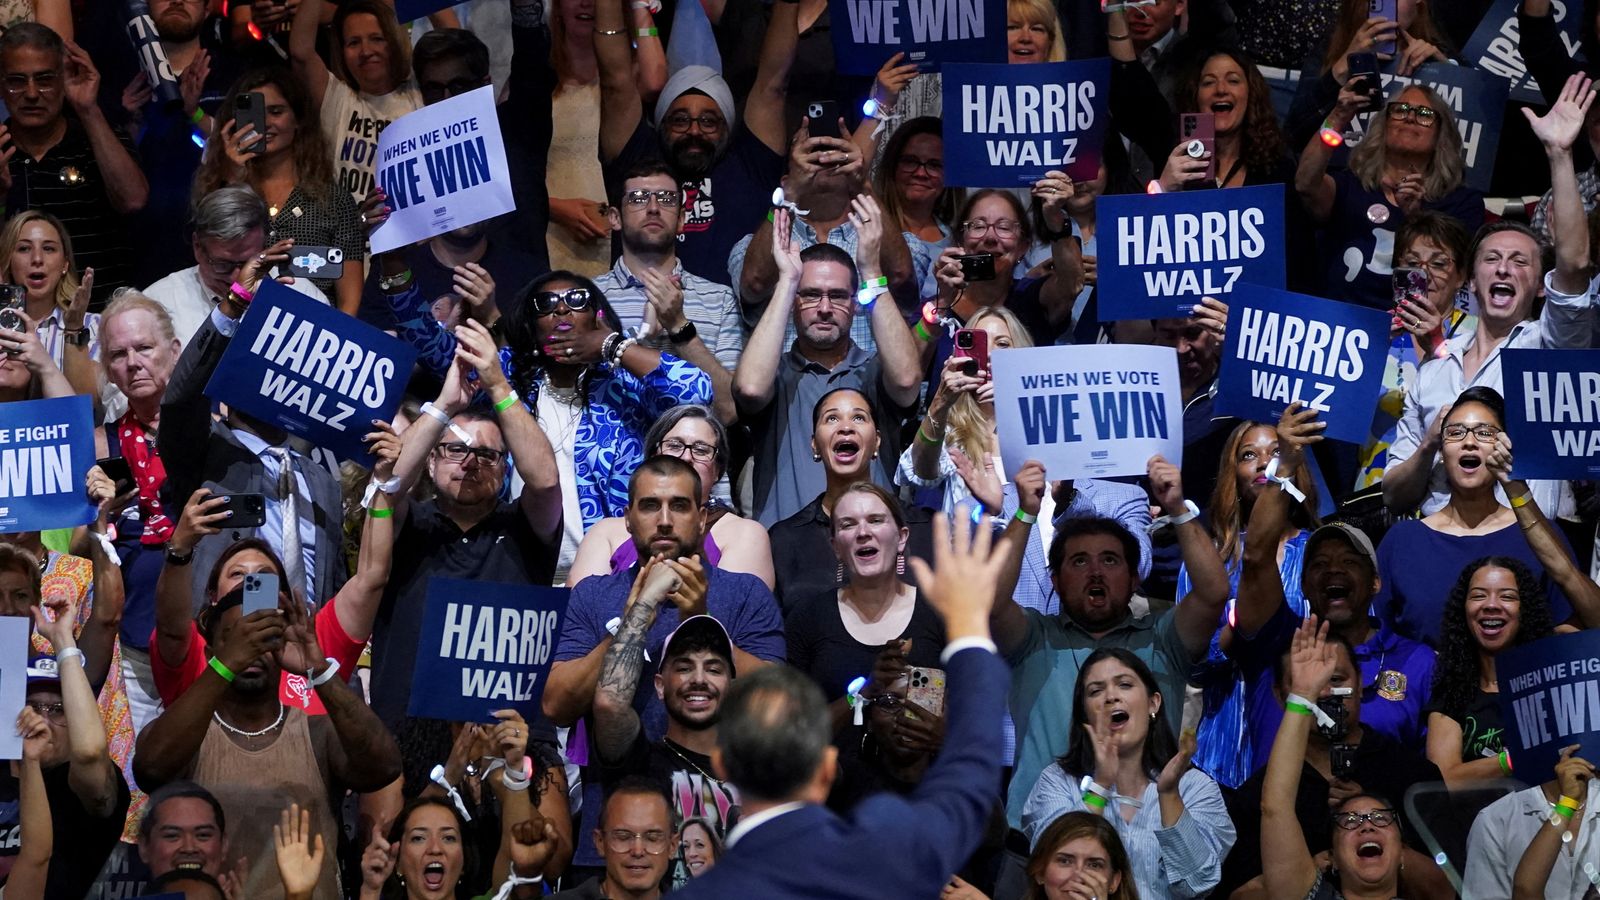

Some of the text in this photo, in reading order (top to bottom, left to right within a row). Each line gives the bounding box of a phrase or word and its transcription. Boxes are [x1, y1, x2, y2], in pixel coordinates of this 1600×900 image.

[847, 0, 985, 44] WE WIN
[962, 80, 1096, 134] HARRIS
[340, 137, 378, 167] NOT
[383, 117, 479, 162] WHEN WE VOTE
[986, 138, 1078, 166] WALZ
[380, 136, 492, 213] WE WIN
[1117, 207, 1265, 266] HARRIS
[250, 305, 395, 409] HARRIS
[1236, 307, 1369, 382] HARRIS
[259, 368, 356, 432] WALZ
[1021, 370, 1160, 389] WHEN WE VOTE
[1251, 369, 1335, 412] WALZ
[1522, 371, 1600, 423] HAR
[15, 423, 70, 443] FIGHT
[1017, 391, 1169, 445] WE WIN
[439, 602, 557, 666] HARRIS
[462, 667, 538, 701] WALZ
[1509, 657, 1600, 693] WHEN WE FIG
[1512, 679, 1600, 750] WE WI
